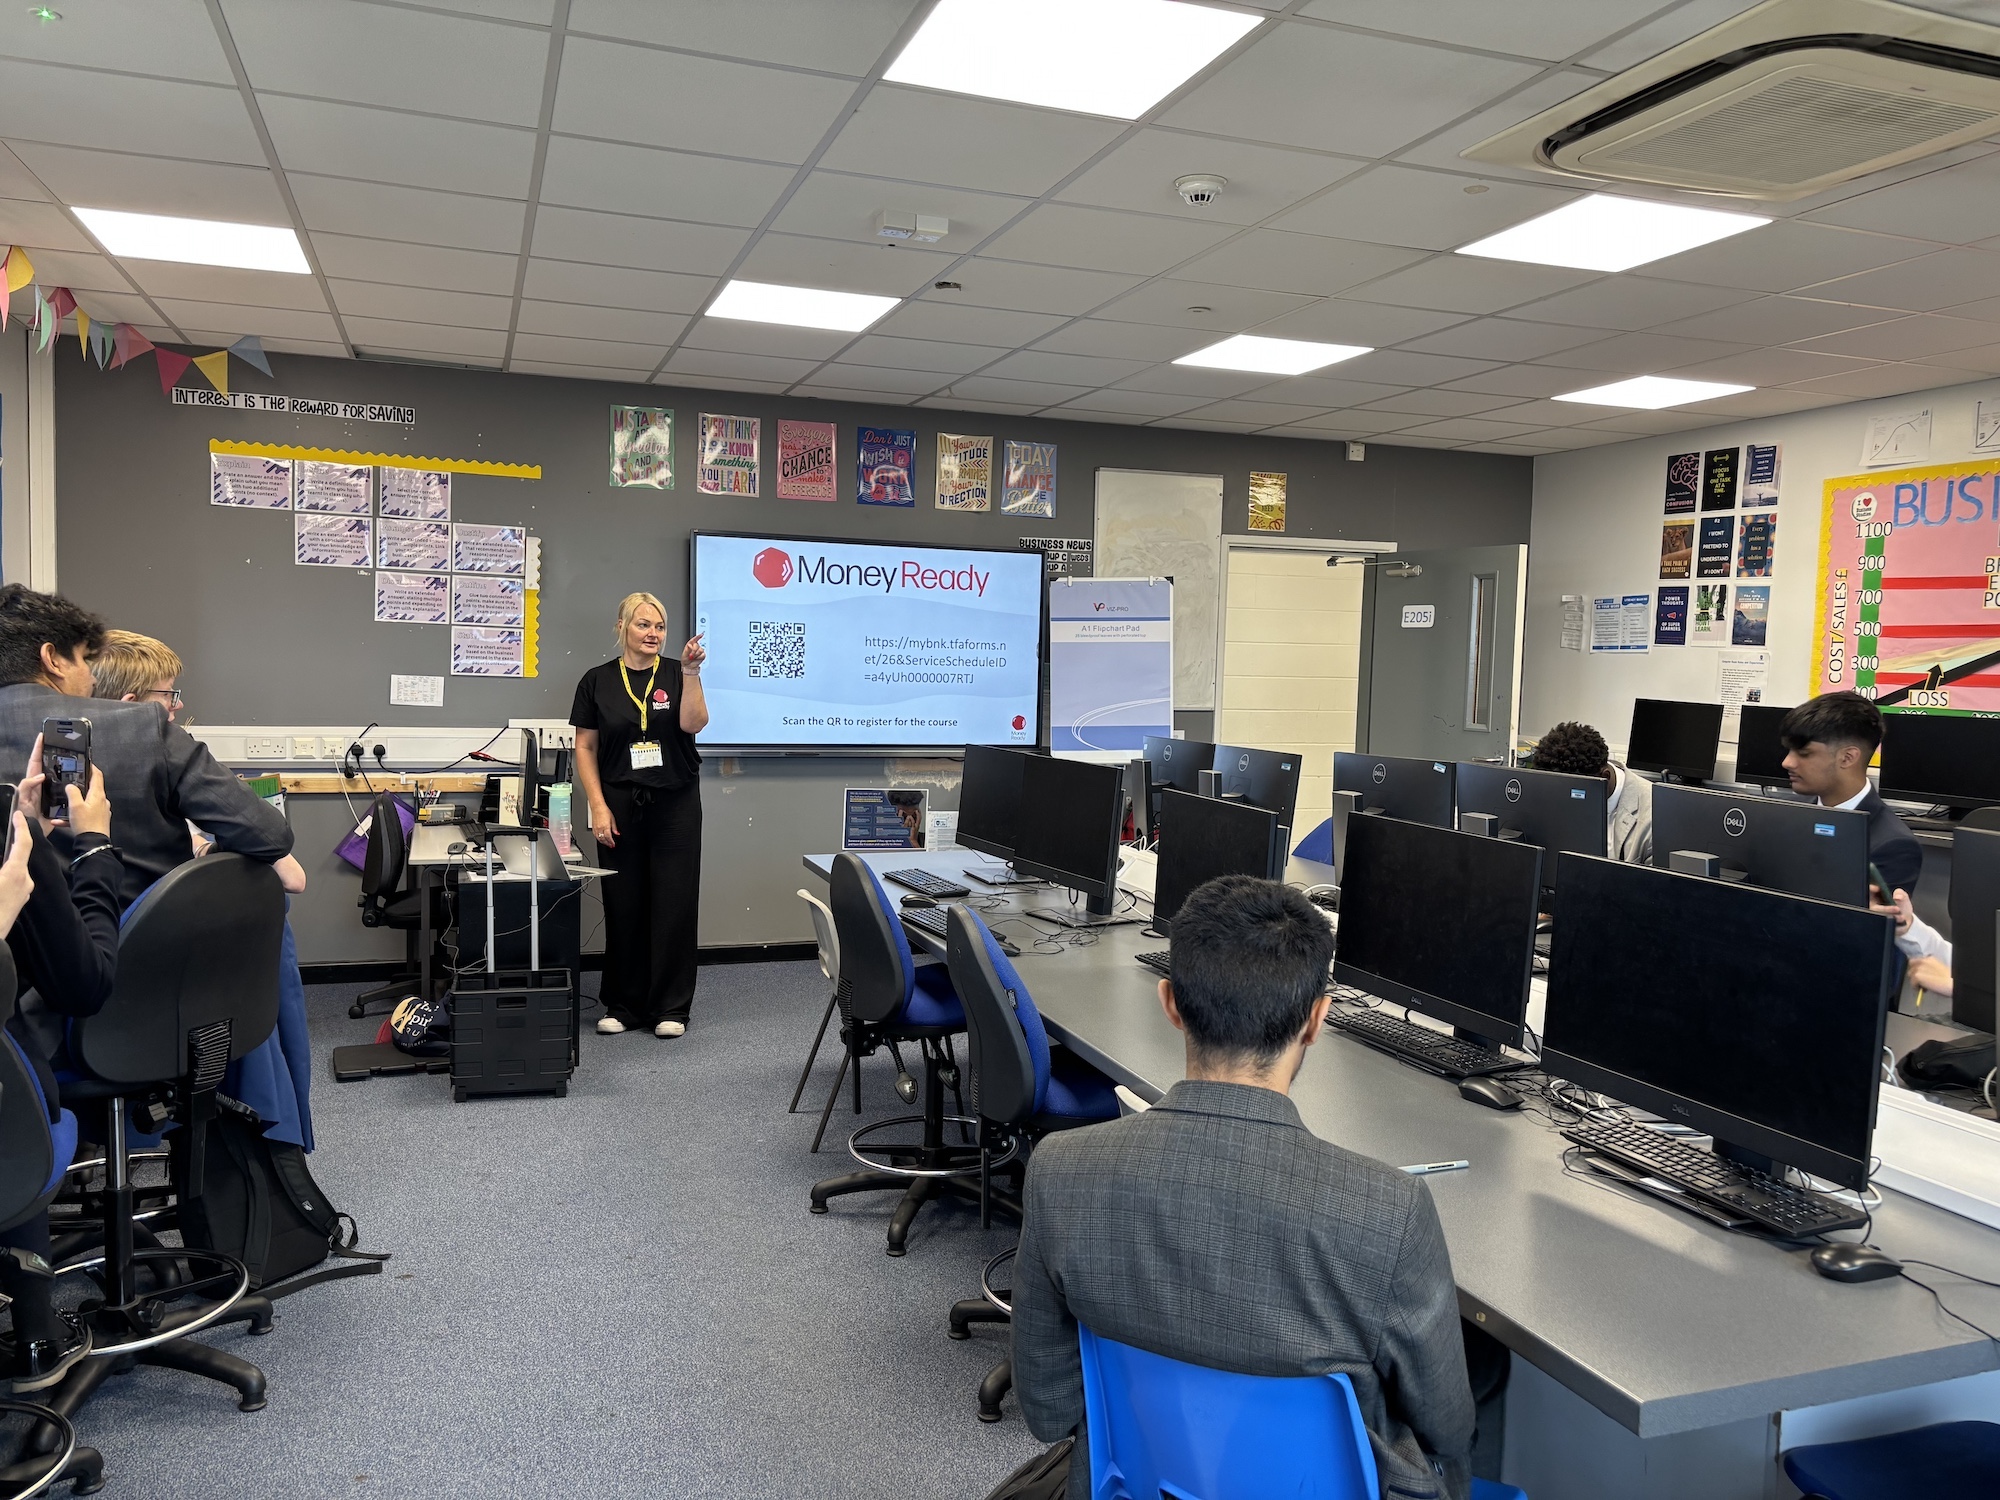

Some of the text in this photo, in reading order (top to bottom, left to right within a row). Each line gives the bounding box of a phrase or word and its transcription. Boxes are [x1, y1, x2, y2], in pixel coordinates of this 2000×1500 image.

[702, 417, 757, 439] EVERYTHING
[782, 424, 832, 445] Everyone
[863, 430, 911, 446] Don't JUST
[951, 438, 975, 453] Your
[635, 456, 651, 467] AND
[782, 447, 831, 477] CHANCE
[864, 448, 893, 466] WISH
[1007, 444, 1055, 466] TODAY
[702, 469, 718, 480] YOU
[721, 470, 756, 493] LEARN
[799, 472, 826, 482] make
[782, 483, 831, 498] DIFFERENCE
[950, 480, 973, 494] Your
[940, 488, 986, 505] DIRECTION
[1855, 522, 1893, 538] 1100
[1020, 539, 1091, 550] BUSINESS NEWS
[1857, 555, 1886, 571] 900
[1855, 591, 1883, 605] 700
[1404, 612, 1431, 623] E205i
[1853, 622, 1882, 636] 500
[865, 636, 1006, 650] https://mybnk.tfaforms.n
[864, 653, 1007, 667] et/26&ServiceScheduleID
[1851, 656, 1880, 670] 300
[1910, 691, 1948, 706] LOSS
[782, 716, 958, 727] Scan the QR to register for the course
[1507, 786, 1520, 794] DELL
[1727, 818, 1743, 827] DELL
